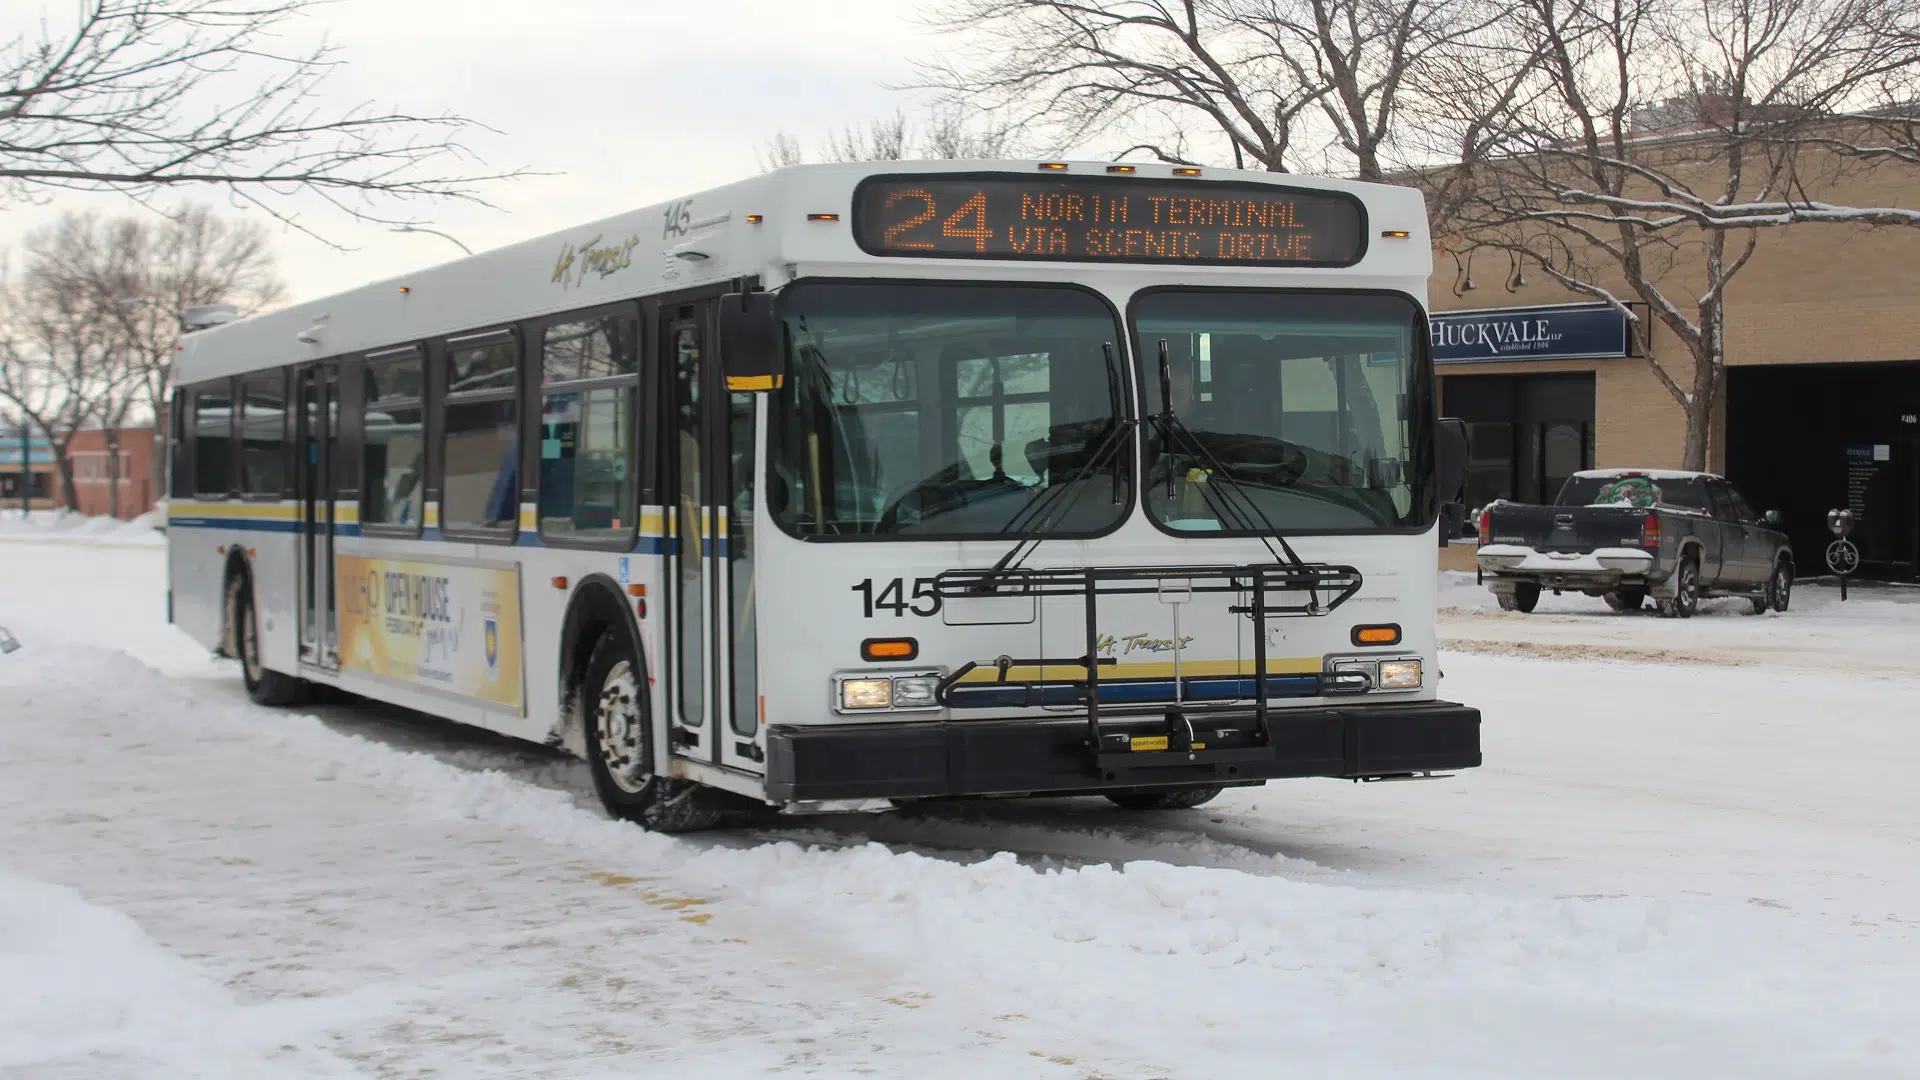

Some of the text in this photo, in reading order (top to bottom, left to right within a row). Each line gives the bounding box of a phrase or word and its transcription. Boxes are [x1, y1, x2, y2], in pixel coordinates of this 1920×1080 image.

[662, 199, 693, 240] 145
[884, 188, 994, 252] 24
[1021, 192, 1304, 228] NORTH TERMINAL
[1008, 226, 1313, 260] VIA SCENIC DRIVE
[1430, 319, 1550, 353] HUCKVALE
[1500, 341, 1531, 351] established
[1901, 414, 1917, 424] #406
[414, 575, 450, 623] HOUSE
[851, 577, 942, 618] 145
